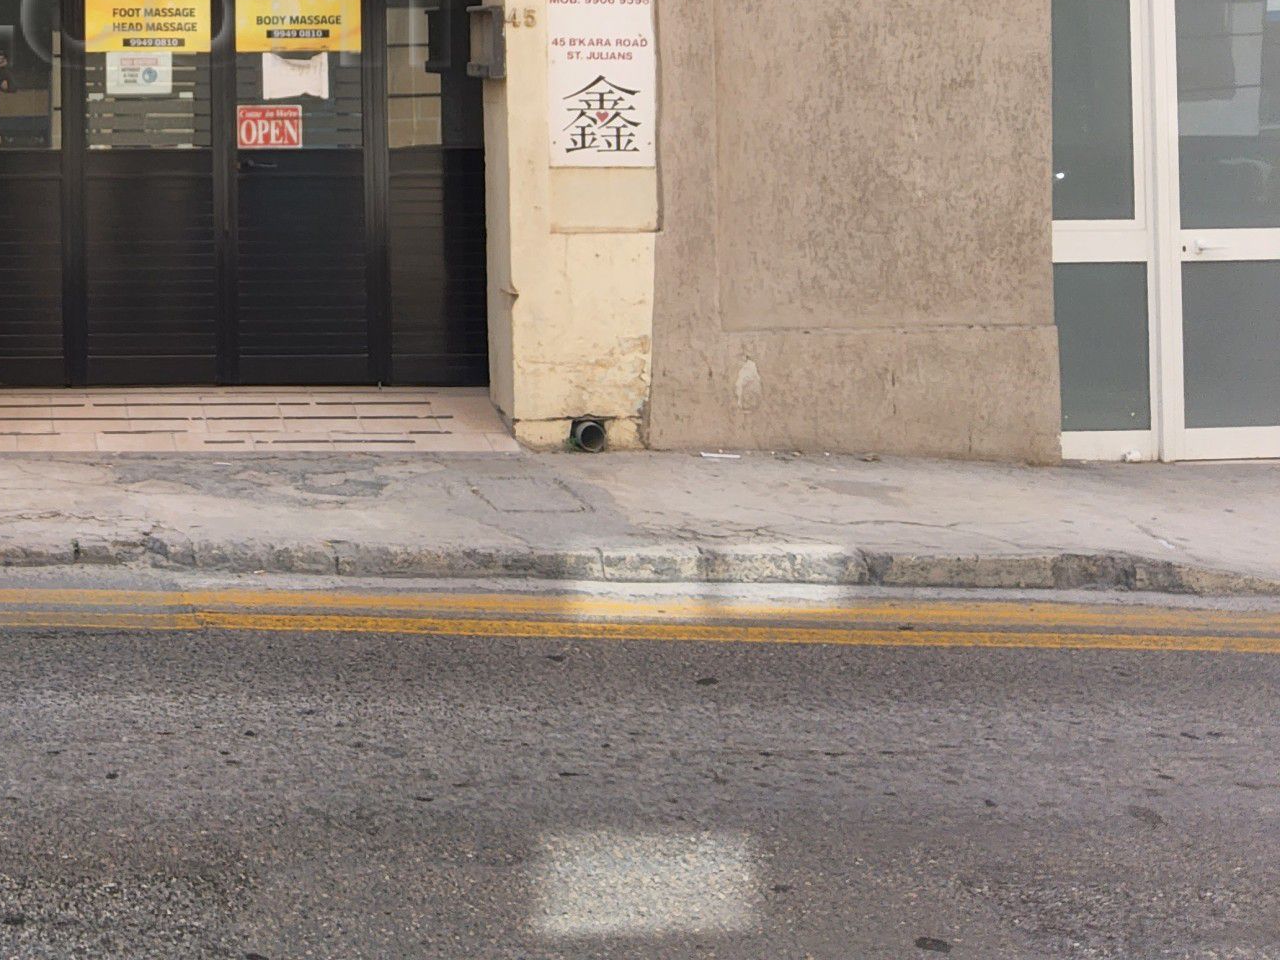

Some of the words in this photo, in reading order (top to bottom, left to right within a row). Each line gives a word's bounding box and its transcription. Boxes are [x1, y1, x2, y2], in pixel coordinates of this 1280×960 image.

[112, 8, 141, 18] FOOT
[144, 8, 196, 18] MASSAGE
[256, 16, 287, 26] BODY
[289, 15, 342, 26] MASSAGE
[112, 22, 143, 32] HEAD
[145, 22, 198, 32] MASSAGE
[273, 29, 297, 37] 9949
[298, 29, 323, 37] 0810
[551, 37, 566, 47] 45
[615, 38, 649, 47] ROAD
[586, 51, 633, 60] JULIANS
[562, 74, 642, 153] 鑫
[240, 120, 298, 144] OPEN
